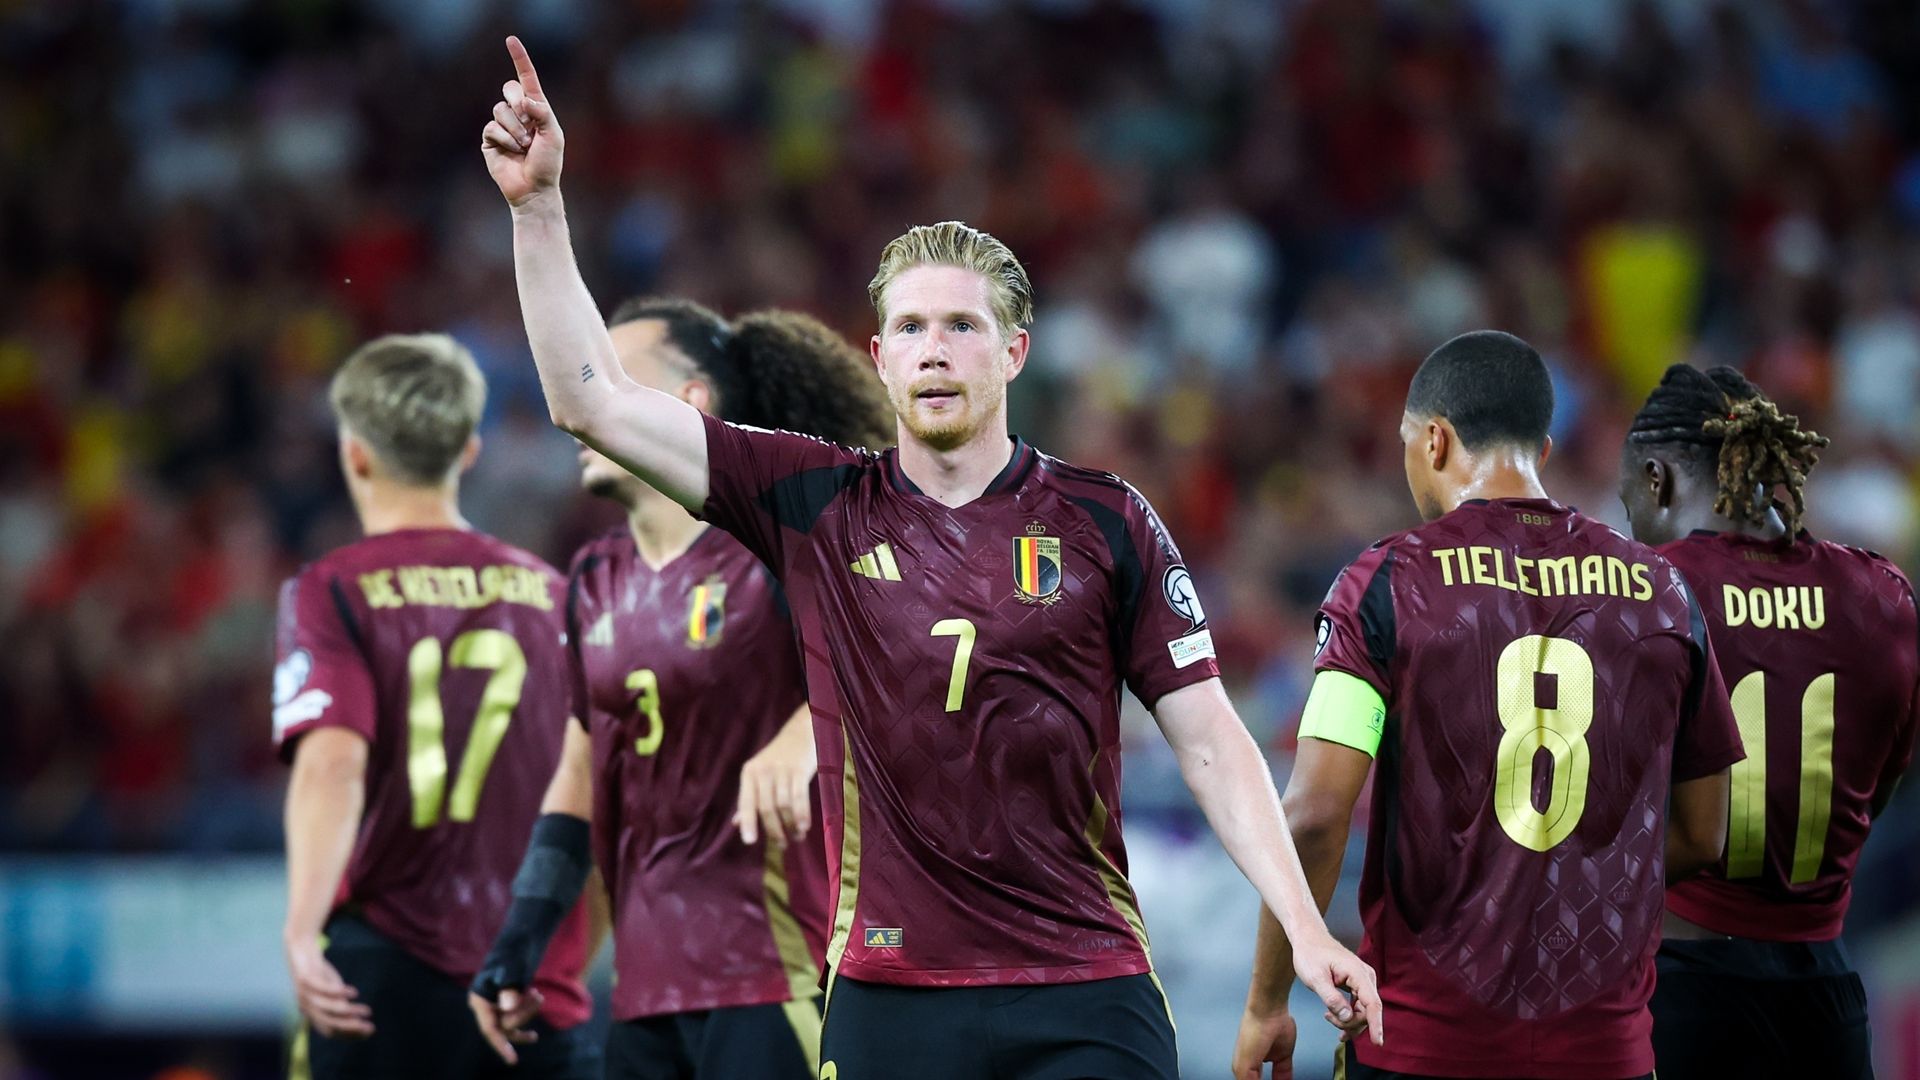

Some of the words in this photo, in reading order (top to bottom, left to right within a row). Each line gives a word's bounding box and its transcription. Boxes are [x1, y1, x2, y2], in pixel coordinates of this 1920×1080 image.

[1515, 513, 1551, 526] 1895
[1432, 546, 1654, 602] TIELEMANS
[1723, 584, 1826, 630] DOKU
[930, 618, 977, 713] 7
[407, 628, 527, 830] 17
[625, 668, 664, 756] 3
[1494, 634, 1594, 852] 8
[1727, 670, 1835, 885] 11
